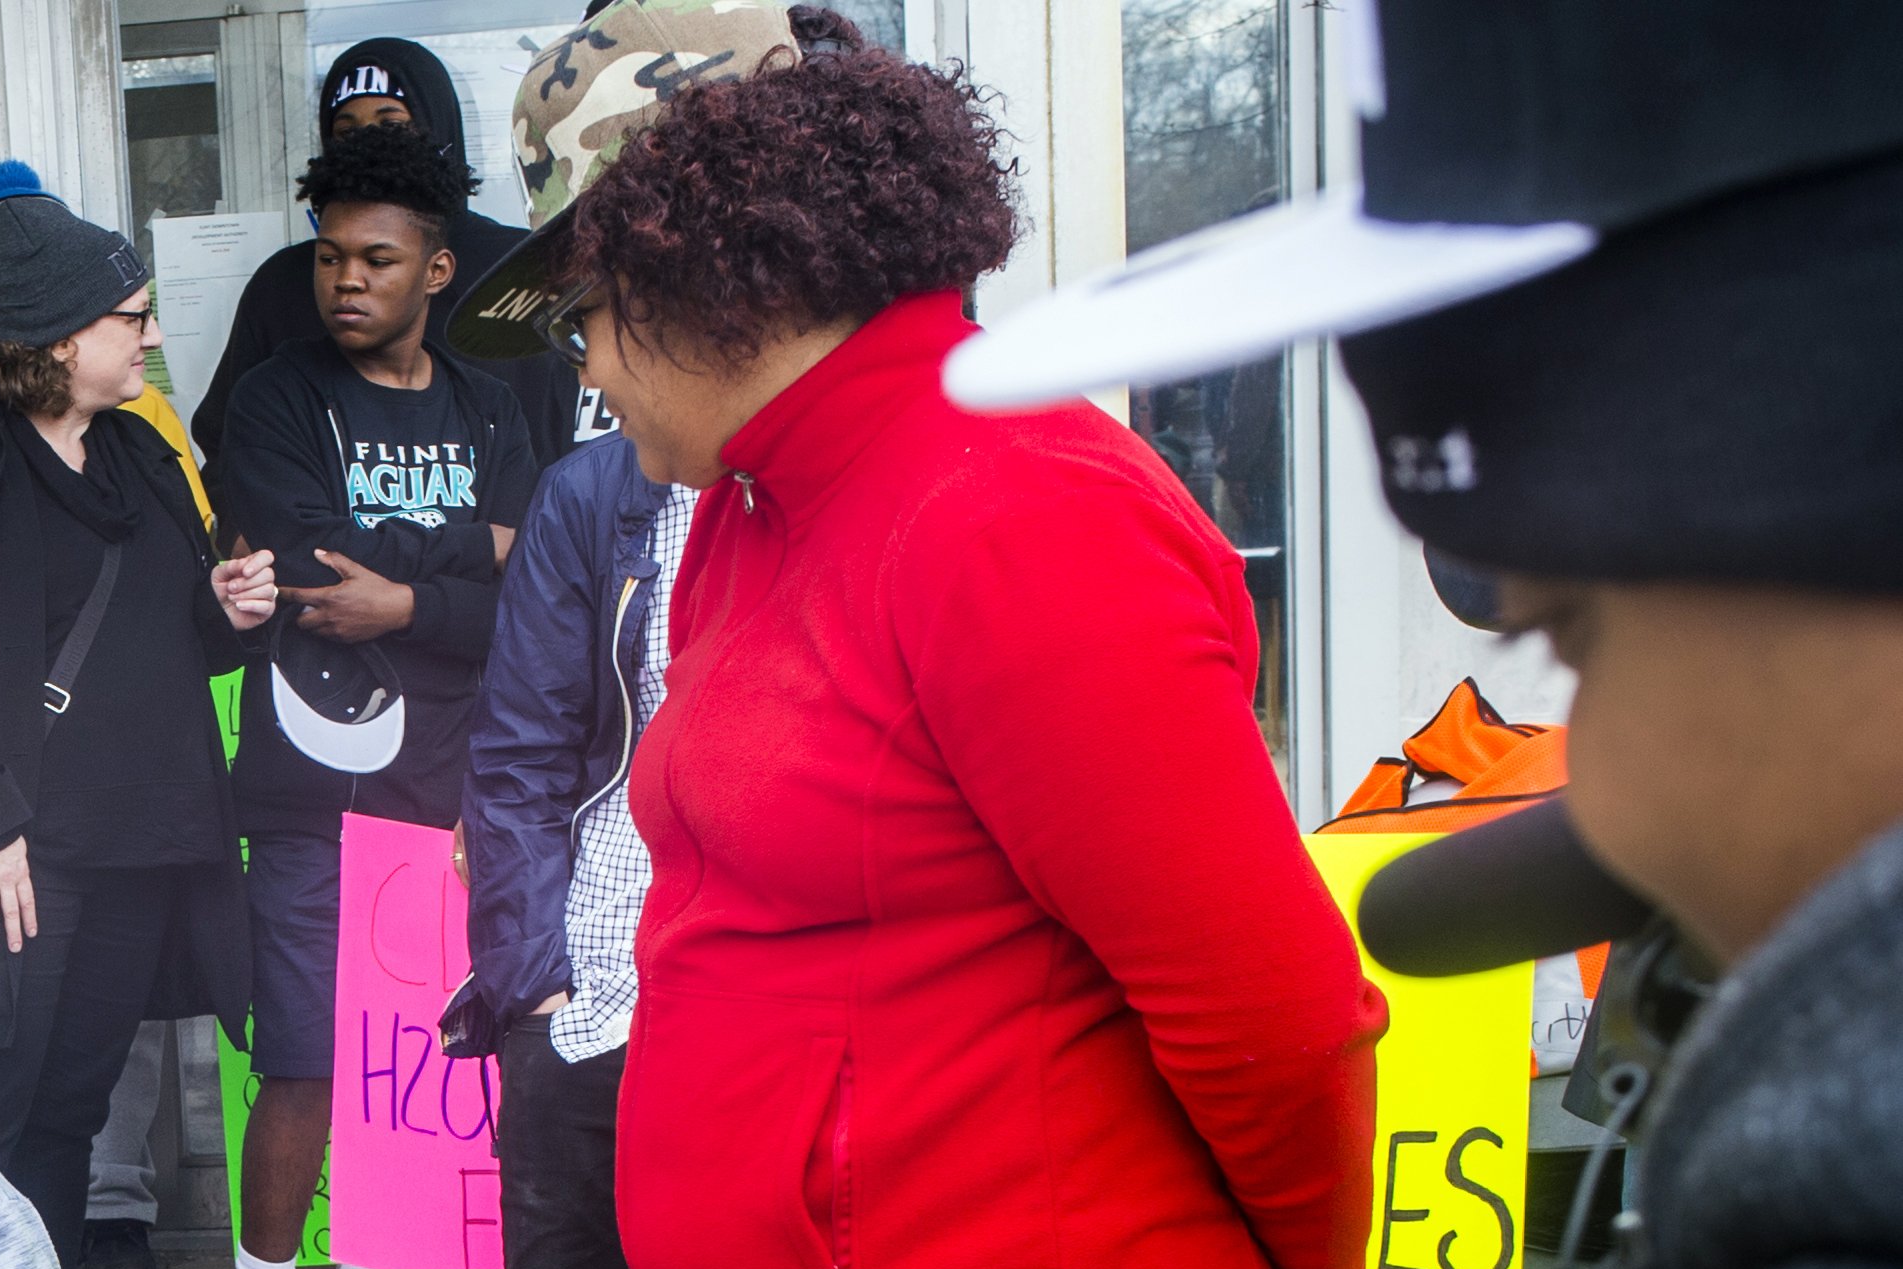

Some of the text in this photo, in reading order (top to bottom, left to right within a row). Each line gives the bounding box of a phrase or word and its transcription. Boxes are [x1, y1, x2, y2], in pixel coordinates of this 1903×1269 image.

[332, 66, 405, 107] LIN
[354, 442, 461, 465] FLINT
[347, 462, 477, 510] AGUAR
